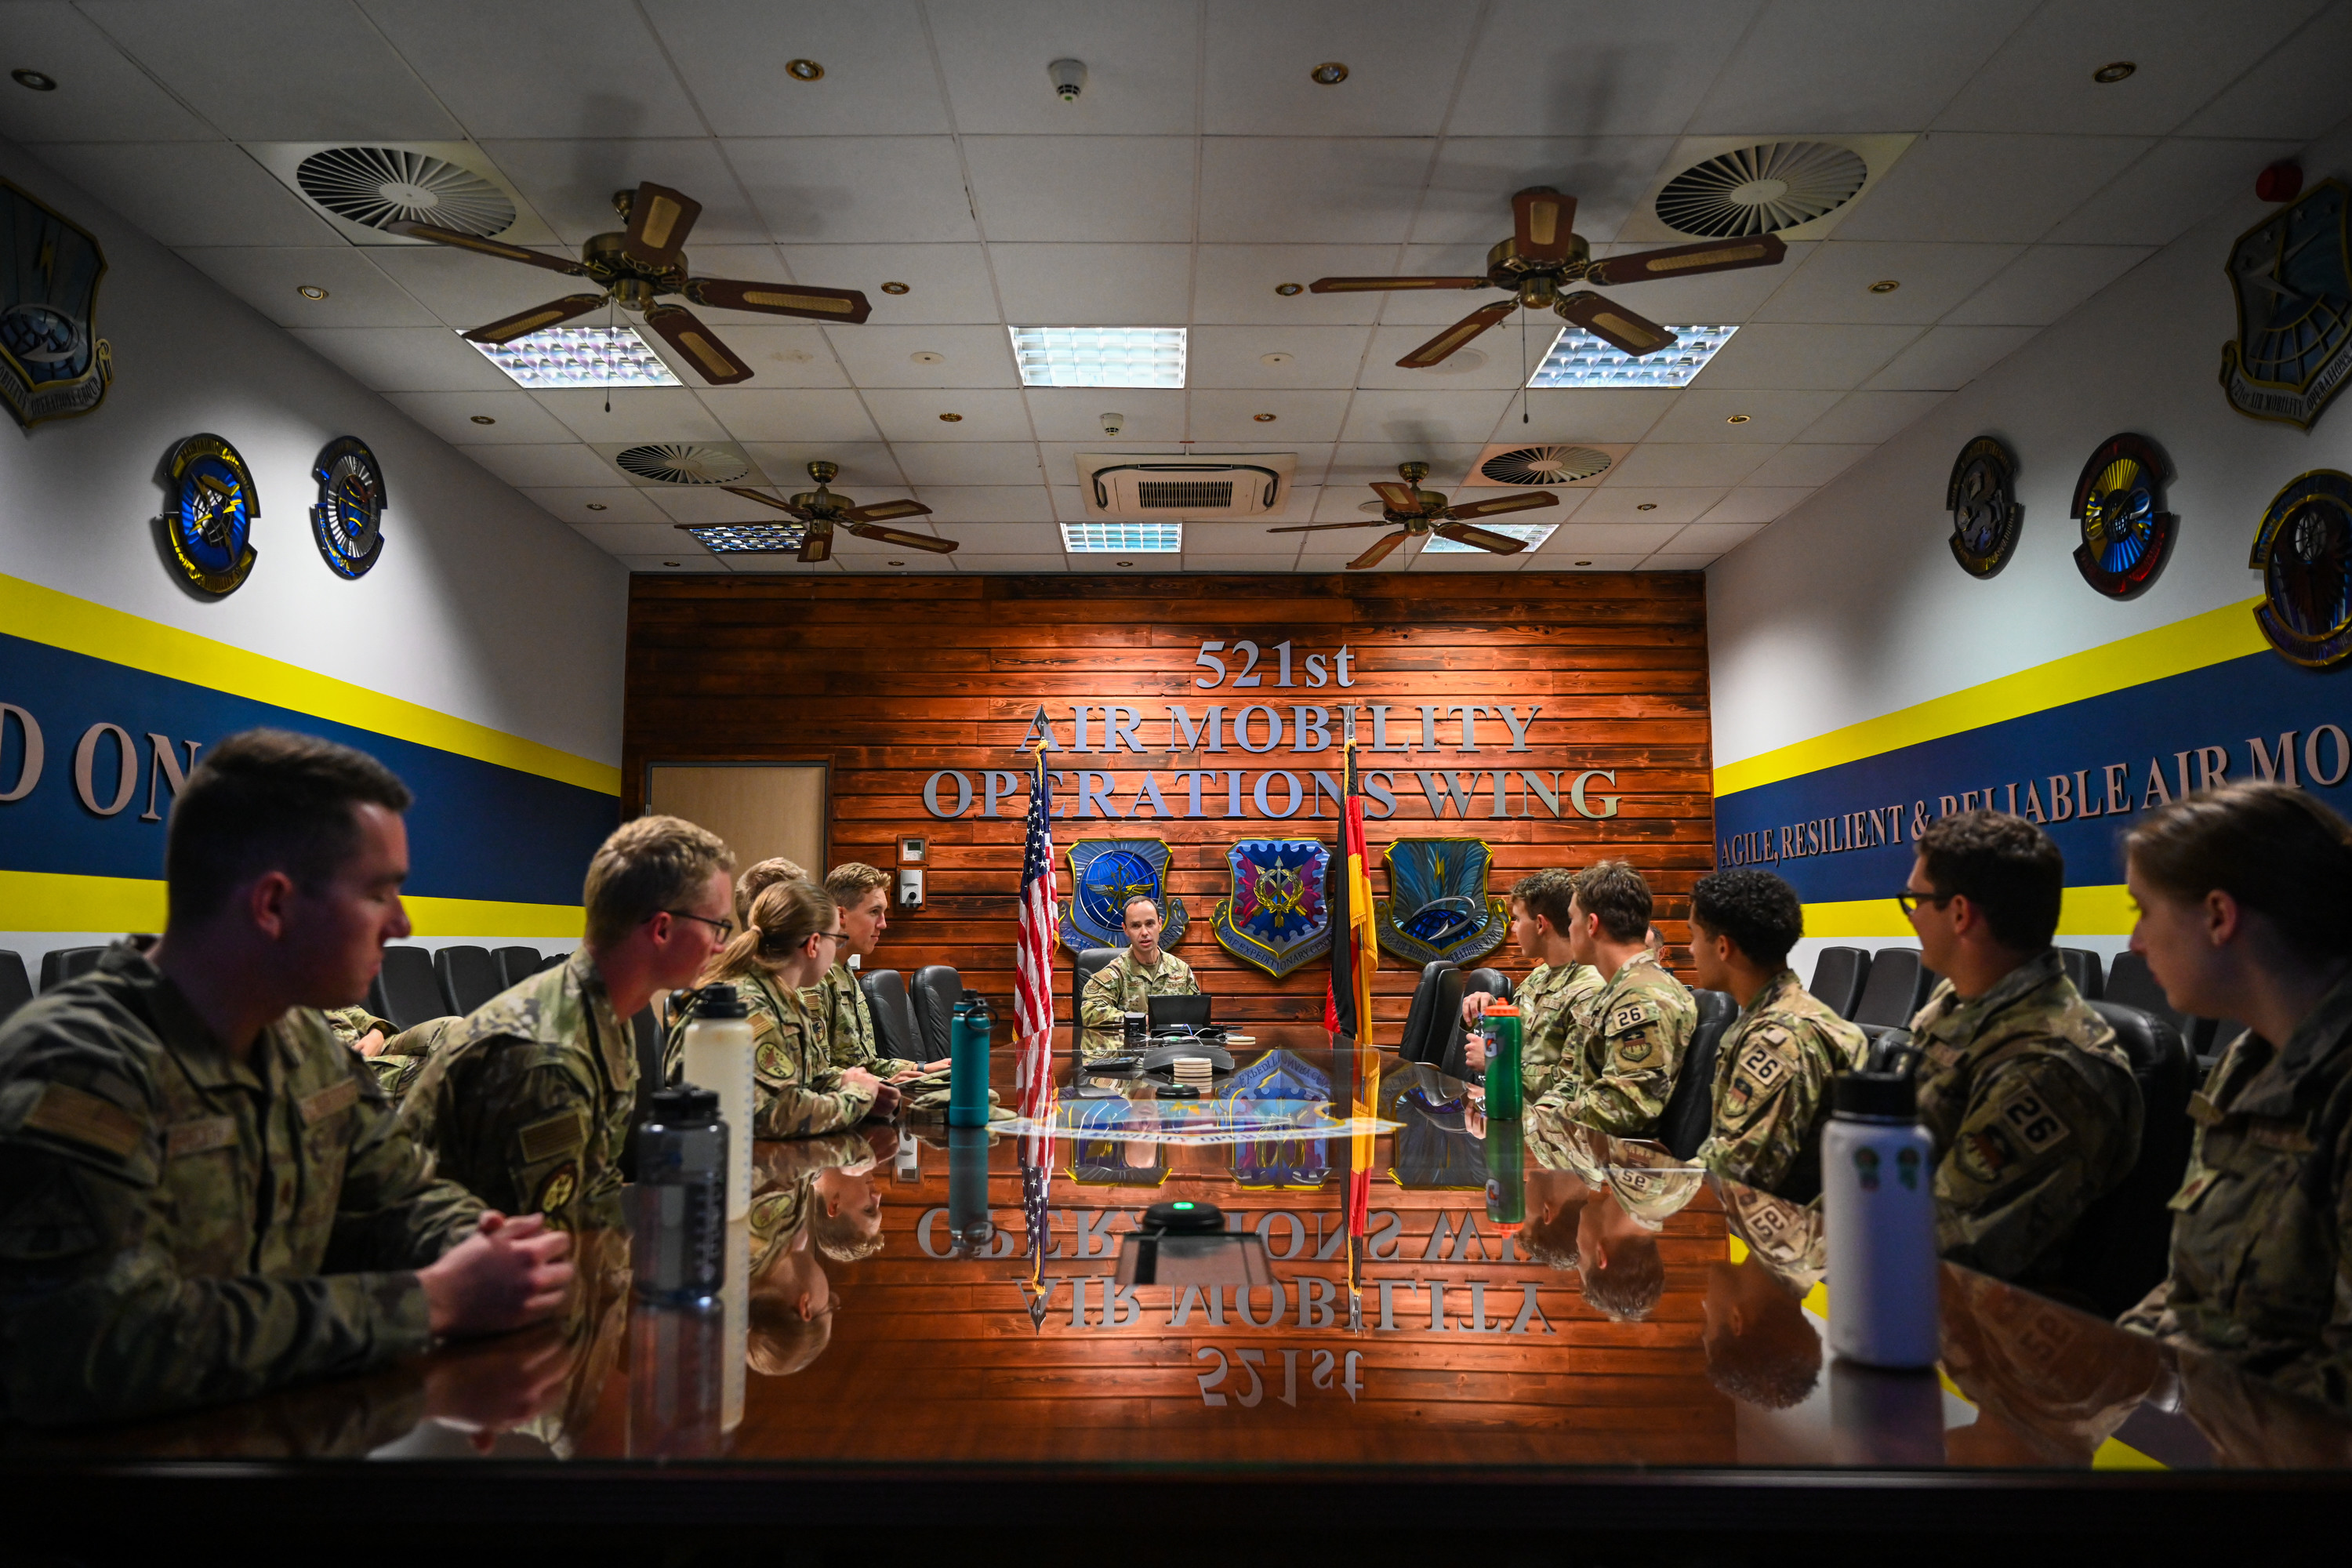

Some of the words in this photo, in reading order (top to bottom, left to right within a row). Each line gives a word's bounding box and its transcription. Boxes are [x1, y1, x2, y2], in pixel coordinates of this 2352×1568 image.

[2266, 394, 2303, 417] MOBILITY
[2306, 350, 2352, 412] OPERATIONS
[1196, 640, 1356, 688] 521st
[1015, 705, 1148, 753] AIR
[1165, 705, 1542, 753] MOBILITY
[1414, 769, 1622, 818] WING
[1720, 828, 1780, 866] AGILE,
[1780, 804, 1904, 859] RESILIENT
[1911, 800, 1932, 840] &
[2141, 746, 2228, 809] AIR
[1220, 926, 1239, 947] USAF
[1240, 942, 1310, 971] EXPEDITIONARY
[1310, 929, 1333, 954] CENT
[1481, 928, 1501, 946] WING
[1617, 1007, 1641, 1027] 26
[1746, 1050, 1778, 1078] 26
[2006, 1096, 2059, 1143] 26
